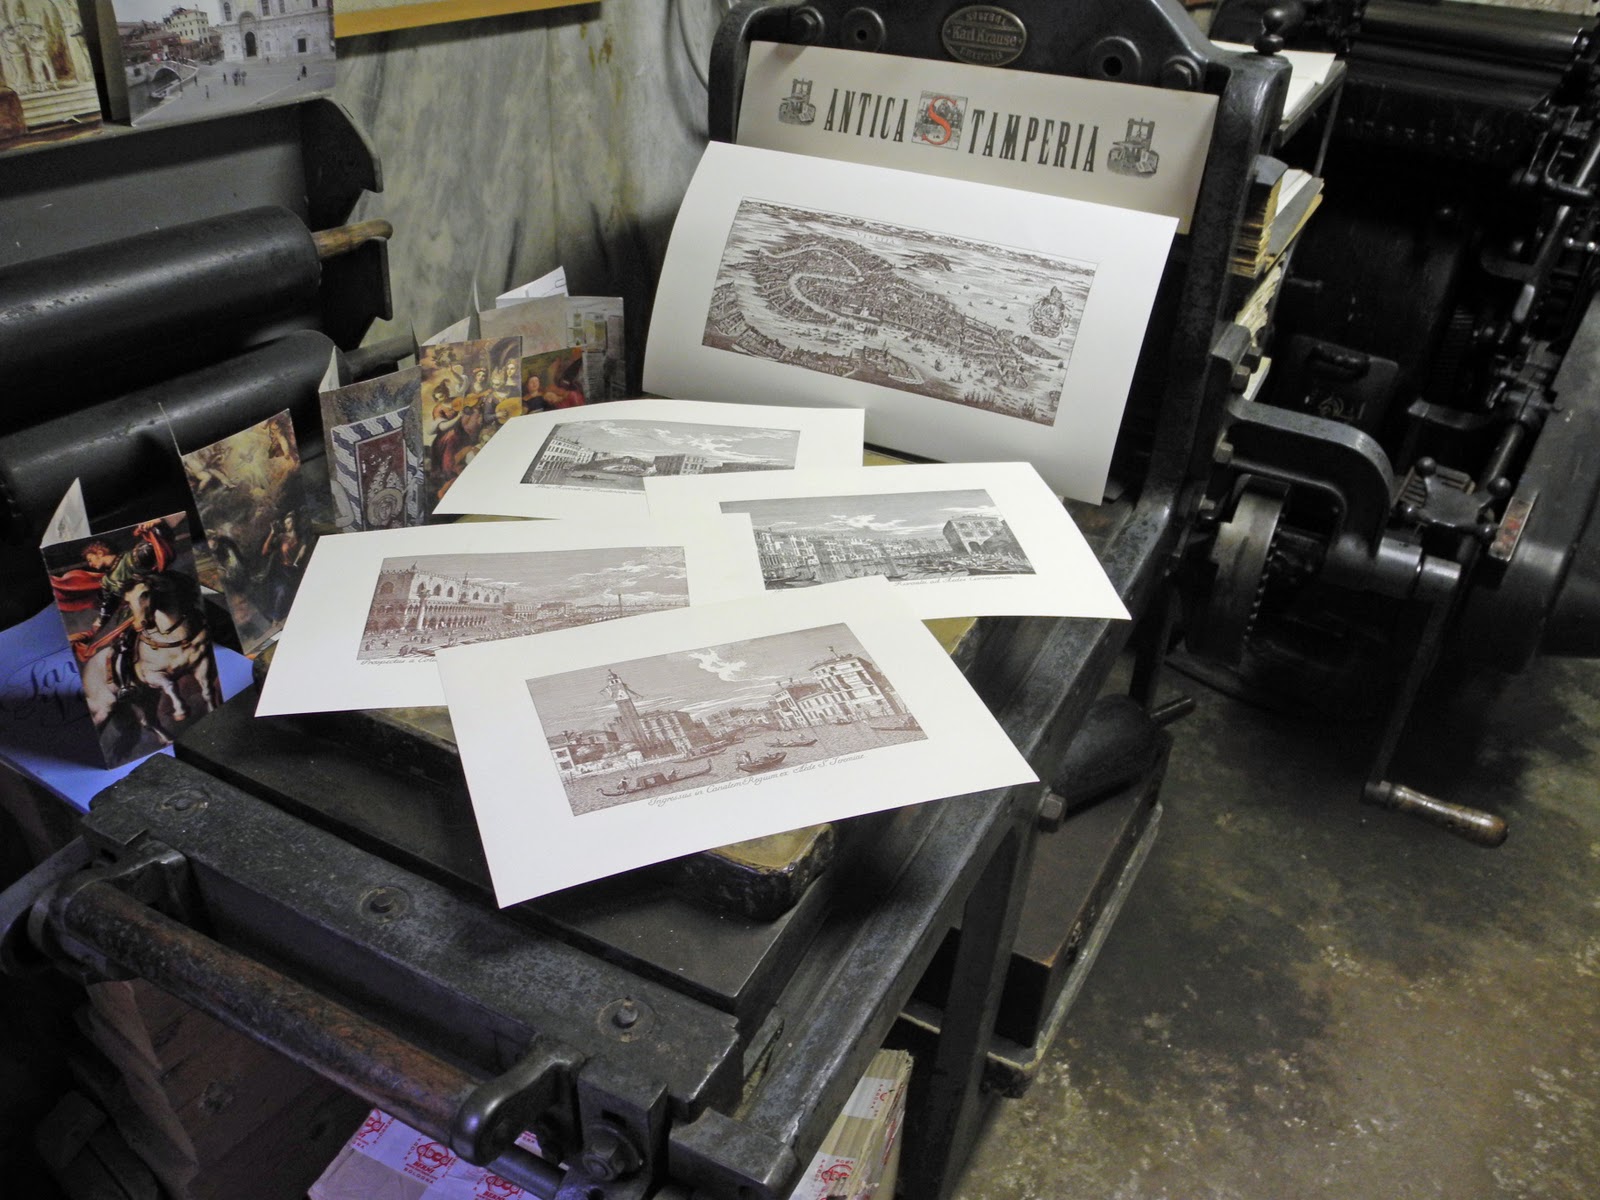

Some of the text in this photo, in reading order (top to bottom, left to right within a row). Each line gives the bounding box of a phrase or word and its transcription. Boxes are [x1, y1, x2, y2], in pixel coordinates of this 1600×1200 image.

[951, 25, 1017, 46] Karl Krause
[823, 88, 908, 143] ANTICA
[693, 789, 703, 797] in
[706, 781, 742, 794] Canalem
[741, 773, 778, 786] Regium
[403, 1166, 434, 1184] BOLOGNA
